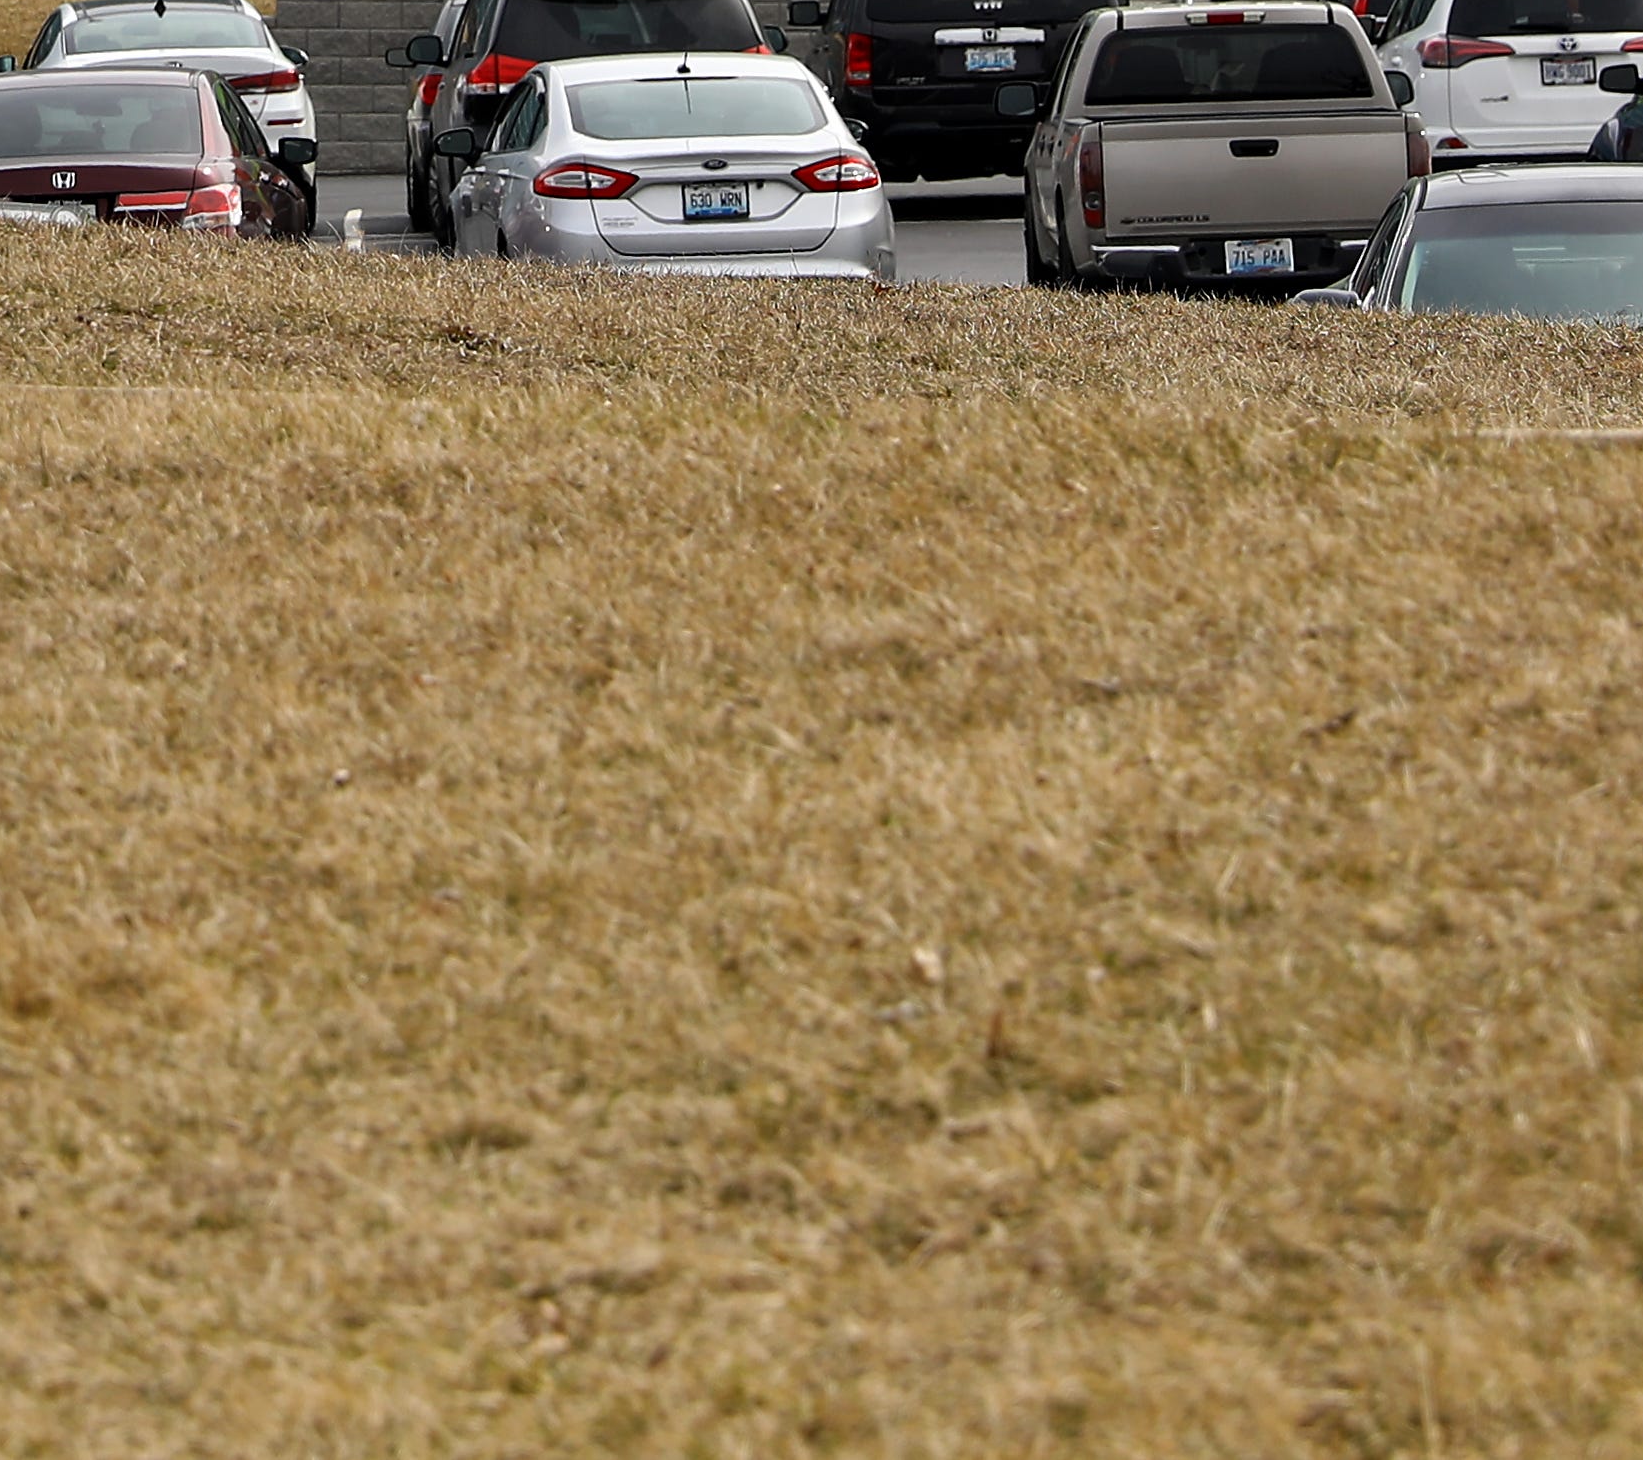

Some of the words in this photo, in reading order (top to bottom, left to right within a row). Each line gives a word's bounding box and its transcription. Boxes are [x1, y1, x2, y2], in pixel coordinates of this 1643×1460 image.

[690, 193, 713, 208] 630
[720, 192, 743, 207] WRN
[1233, 250, 1255, 267] 715
[1263, 249, 1287, 265] PAA
